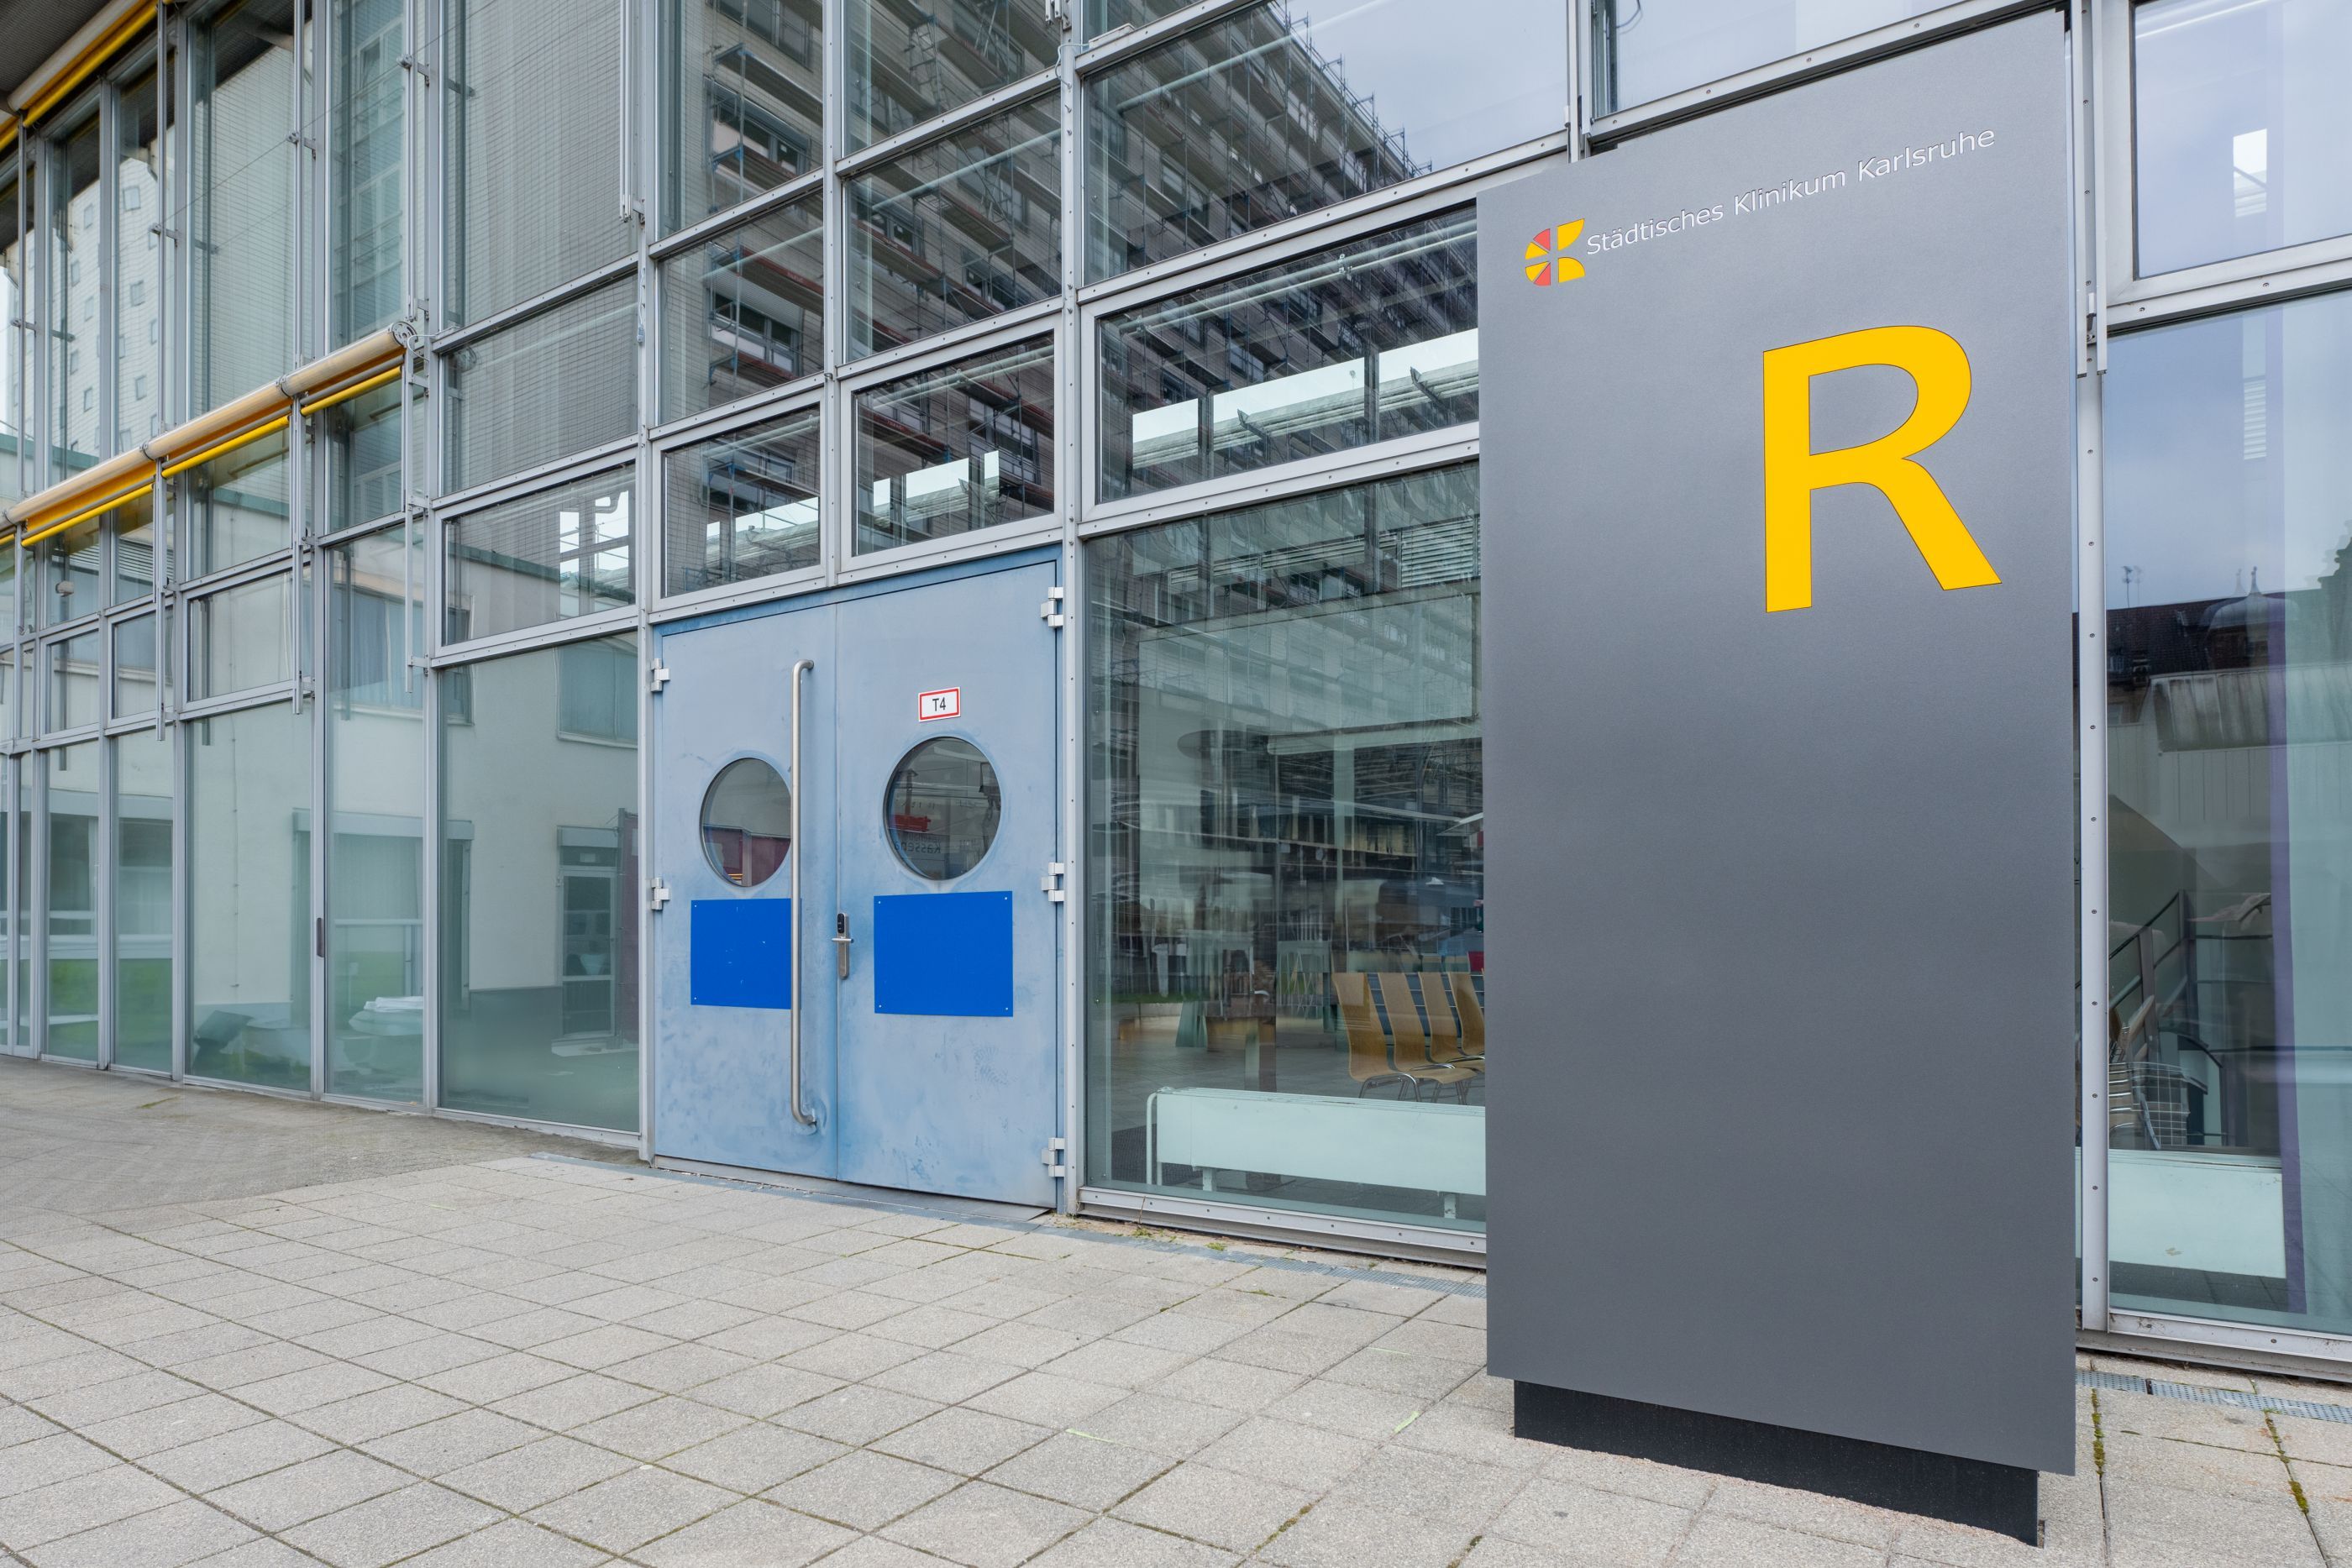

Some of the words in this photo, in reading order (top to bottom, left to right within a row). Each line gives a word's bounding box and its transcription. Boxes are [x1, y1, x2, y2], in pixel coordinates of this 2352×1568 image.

[1587, 204, 1724, 255] Städtisches
[1734, 170, 1845, 216] Klinikum
[1858, 129, 1996, 182] Karlsruhe
[1763, 325, 2003, 613] R
[932, 697, 947, 711] T4
